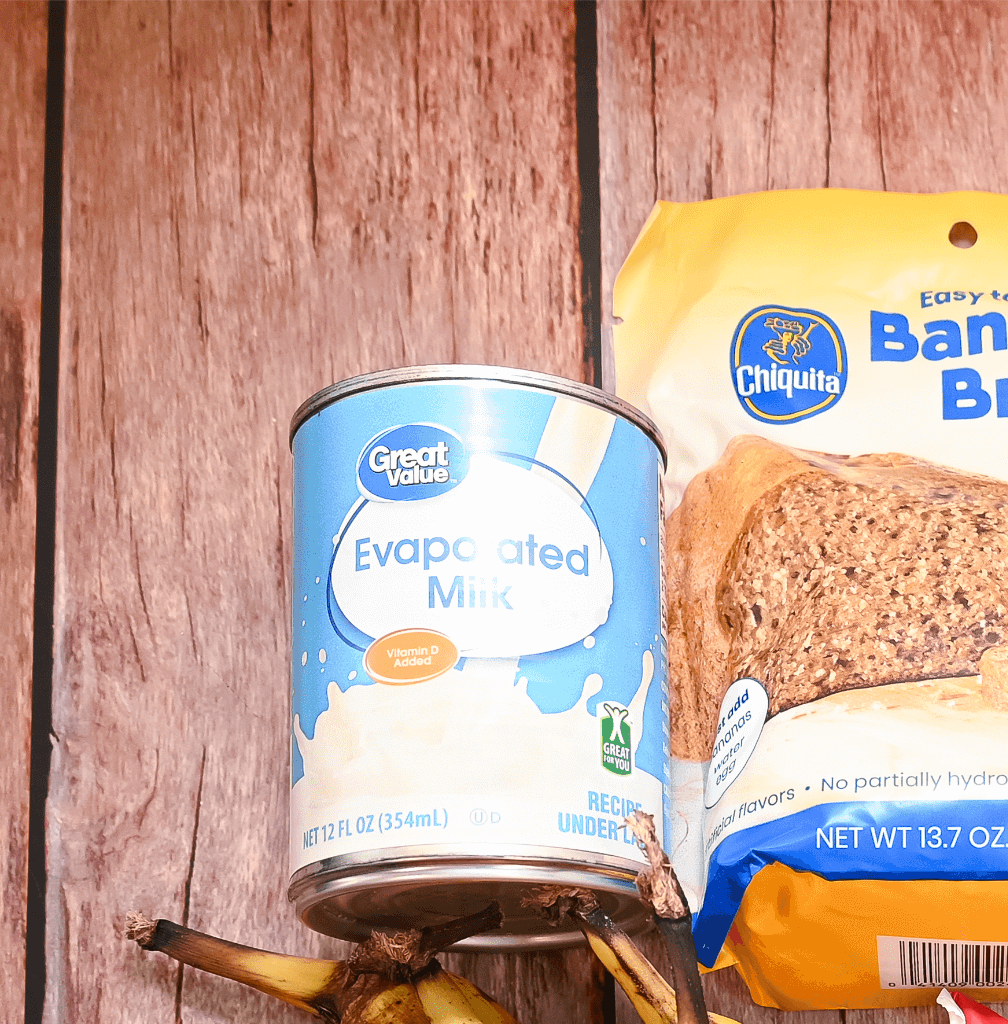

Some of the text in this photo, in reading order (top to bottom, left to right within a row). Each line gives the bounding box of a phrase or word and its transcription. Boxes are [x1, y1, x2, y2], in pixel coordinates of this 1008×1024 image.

[920, 289, 985, 309] Easy
[735, 364, 841, 398] Chiquita
[368, 441, 449, 473] Great
[386, 466, 449, 487] Value
[355, 533, 589, 577] Evapoated
[386, 645, 439, 659] Vitamin D
[393, 655, 432, 668] Added
[728, 689, 749, 719] add
[712, 711, 752, 758] ananas
[603, 742, 630, 759] GREAT
[604, 755, 630, 772] FOR YOU
[714, 736, 745, 773] water
[716, 759, 737, 786] egg
[738, 788, 795, 819] flavors
[821, 777, 848, 792] No
[854, 772, 942, 793] partially
[303, 809, 449, 850] NET 12 FL OZ (354mL)
[558, 812, 618, 841] UNDER
[815, 827, 863, 849] NET
[870, 826, 912, 849] WT
[918, 826, 962, 849] 13.7
